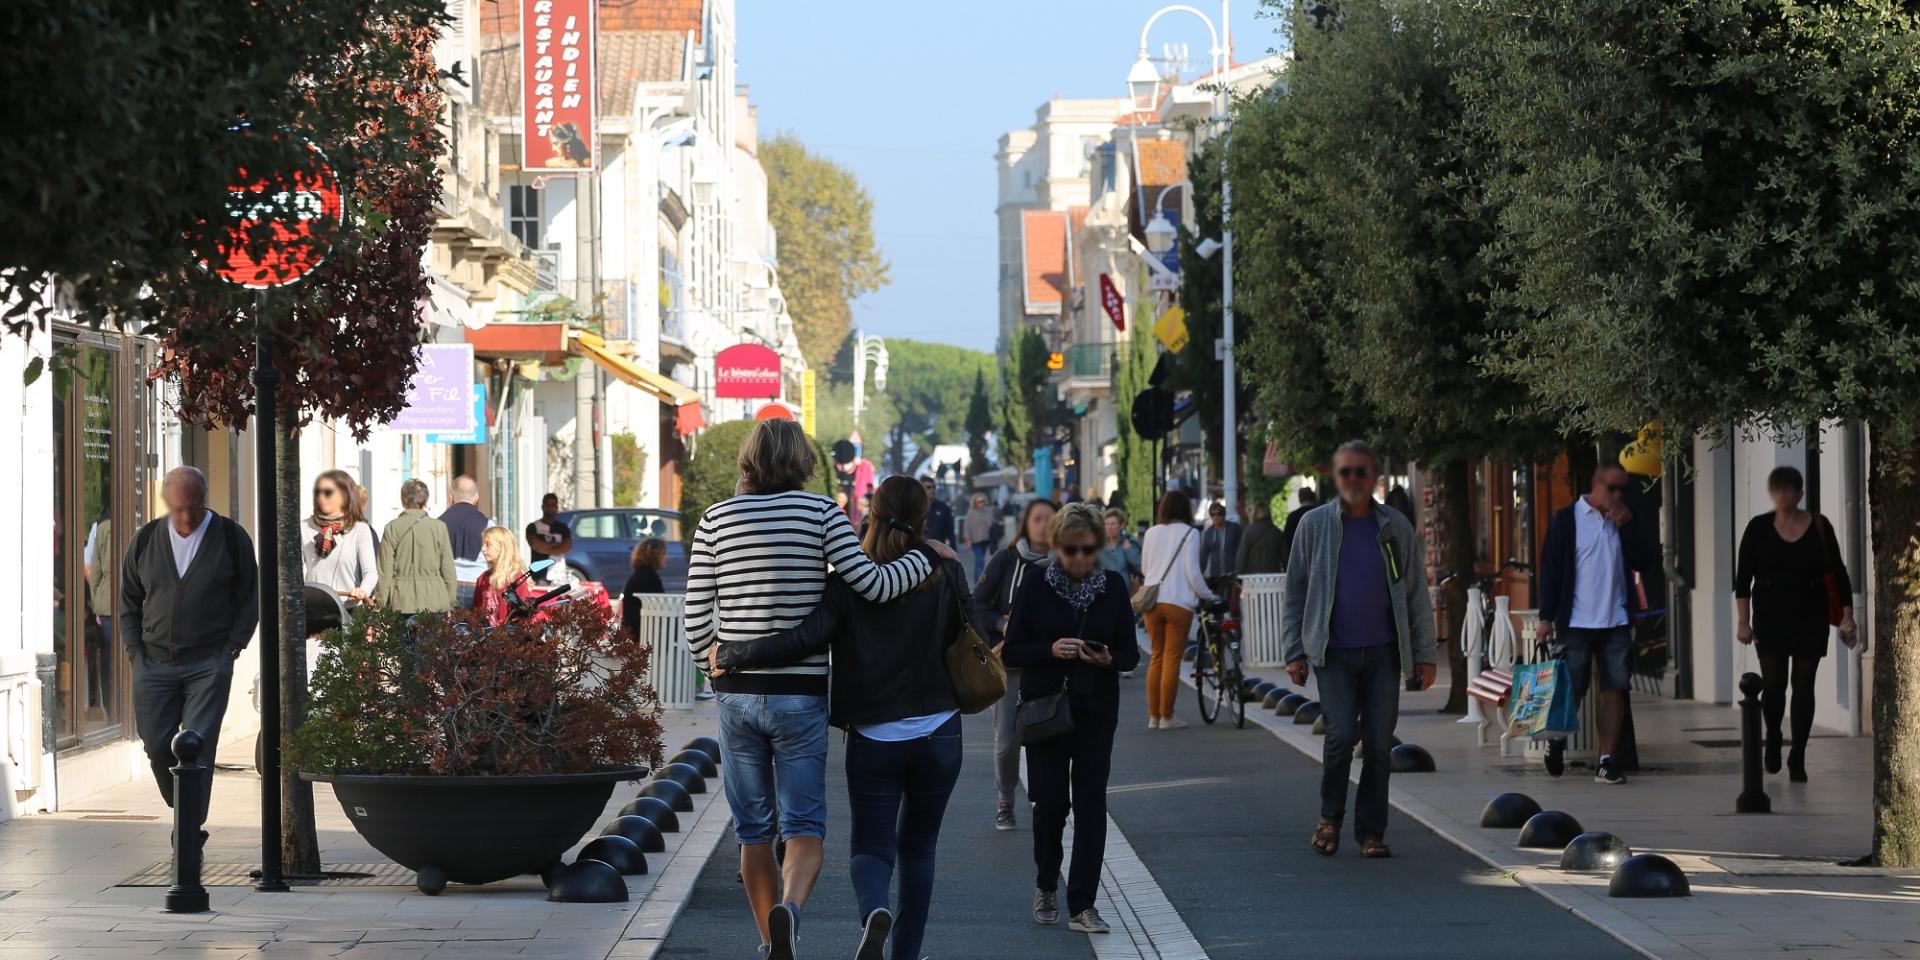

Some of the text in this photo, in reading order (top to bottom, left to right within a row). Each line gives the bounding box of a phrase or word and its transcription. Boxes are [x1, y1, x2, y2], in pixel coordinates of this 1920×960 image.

[533, 0, 554, 138] RESTAURANT
[561, 15, 581, 109] INDIEN
[1105, 285, 1122, 321] TABAC
[718, 367, 730, 378] Le
[428, 386, 461, 402] Fil
